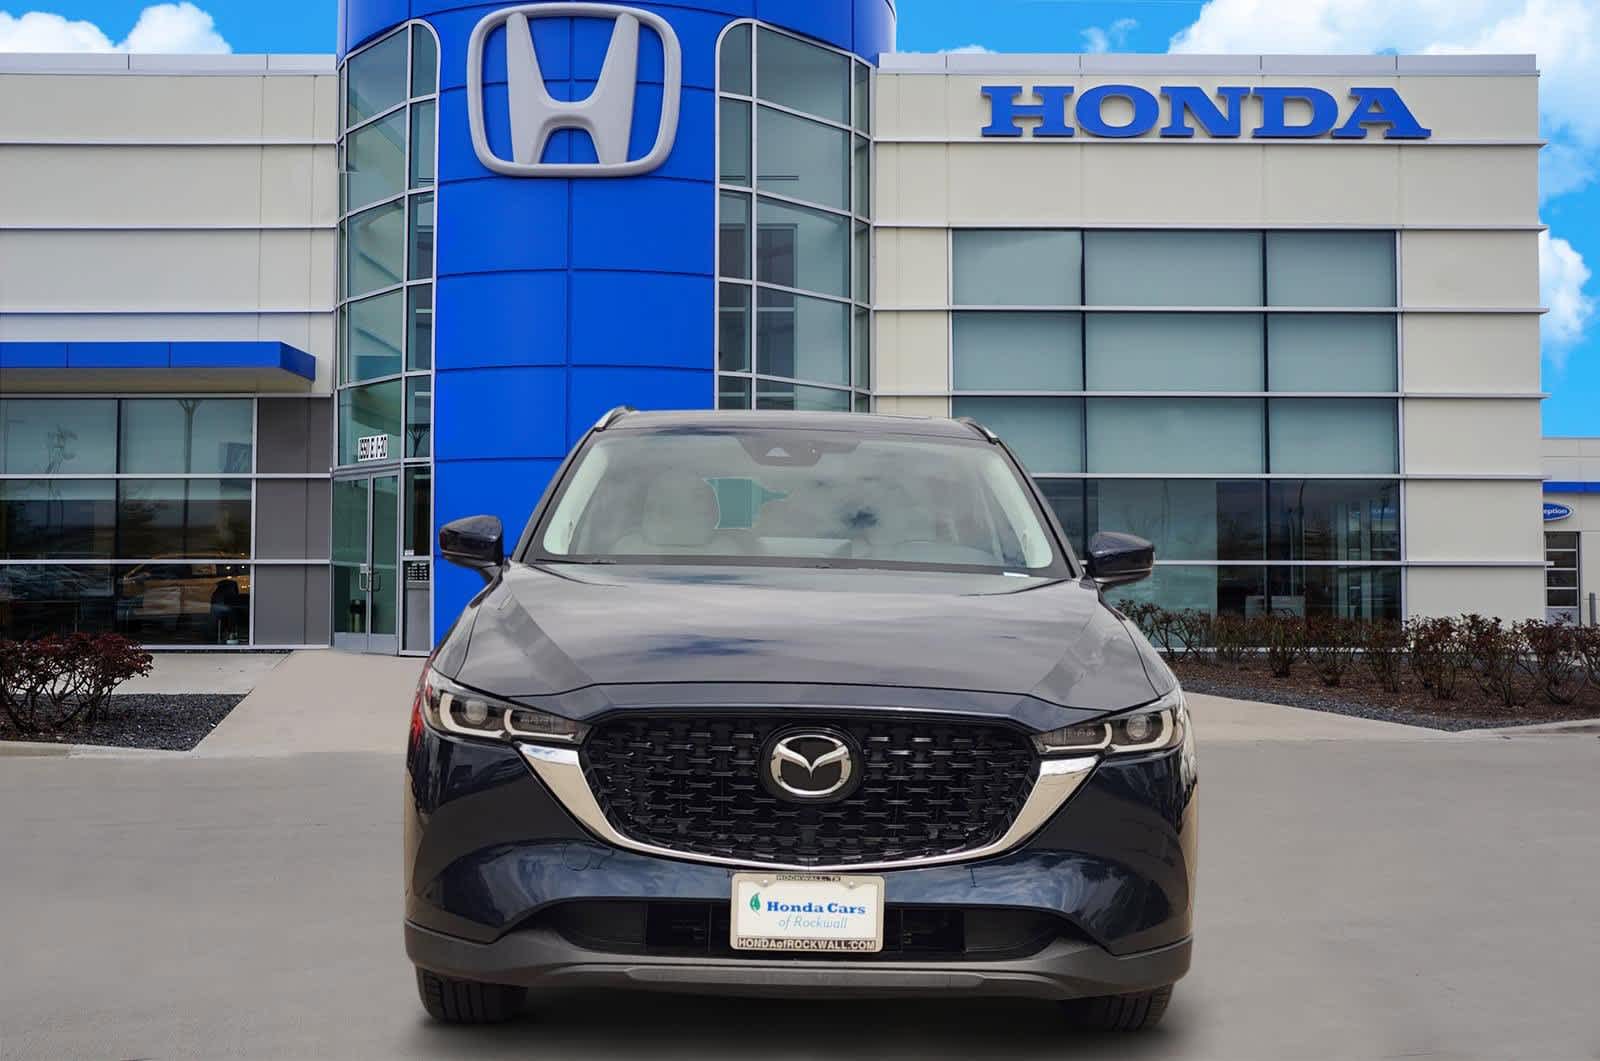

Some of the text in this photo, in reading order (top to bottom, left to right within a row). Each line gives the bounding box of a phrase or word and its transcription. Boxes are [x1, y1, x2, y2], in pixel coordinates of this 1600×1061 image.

[981, 84, 1432, 139] HONDA
[767, 901, 866, 914] Honda Cars
[778, 914, 848, 931] of Rockwall
